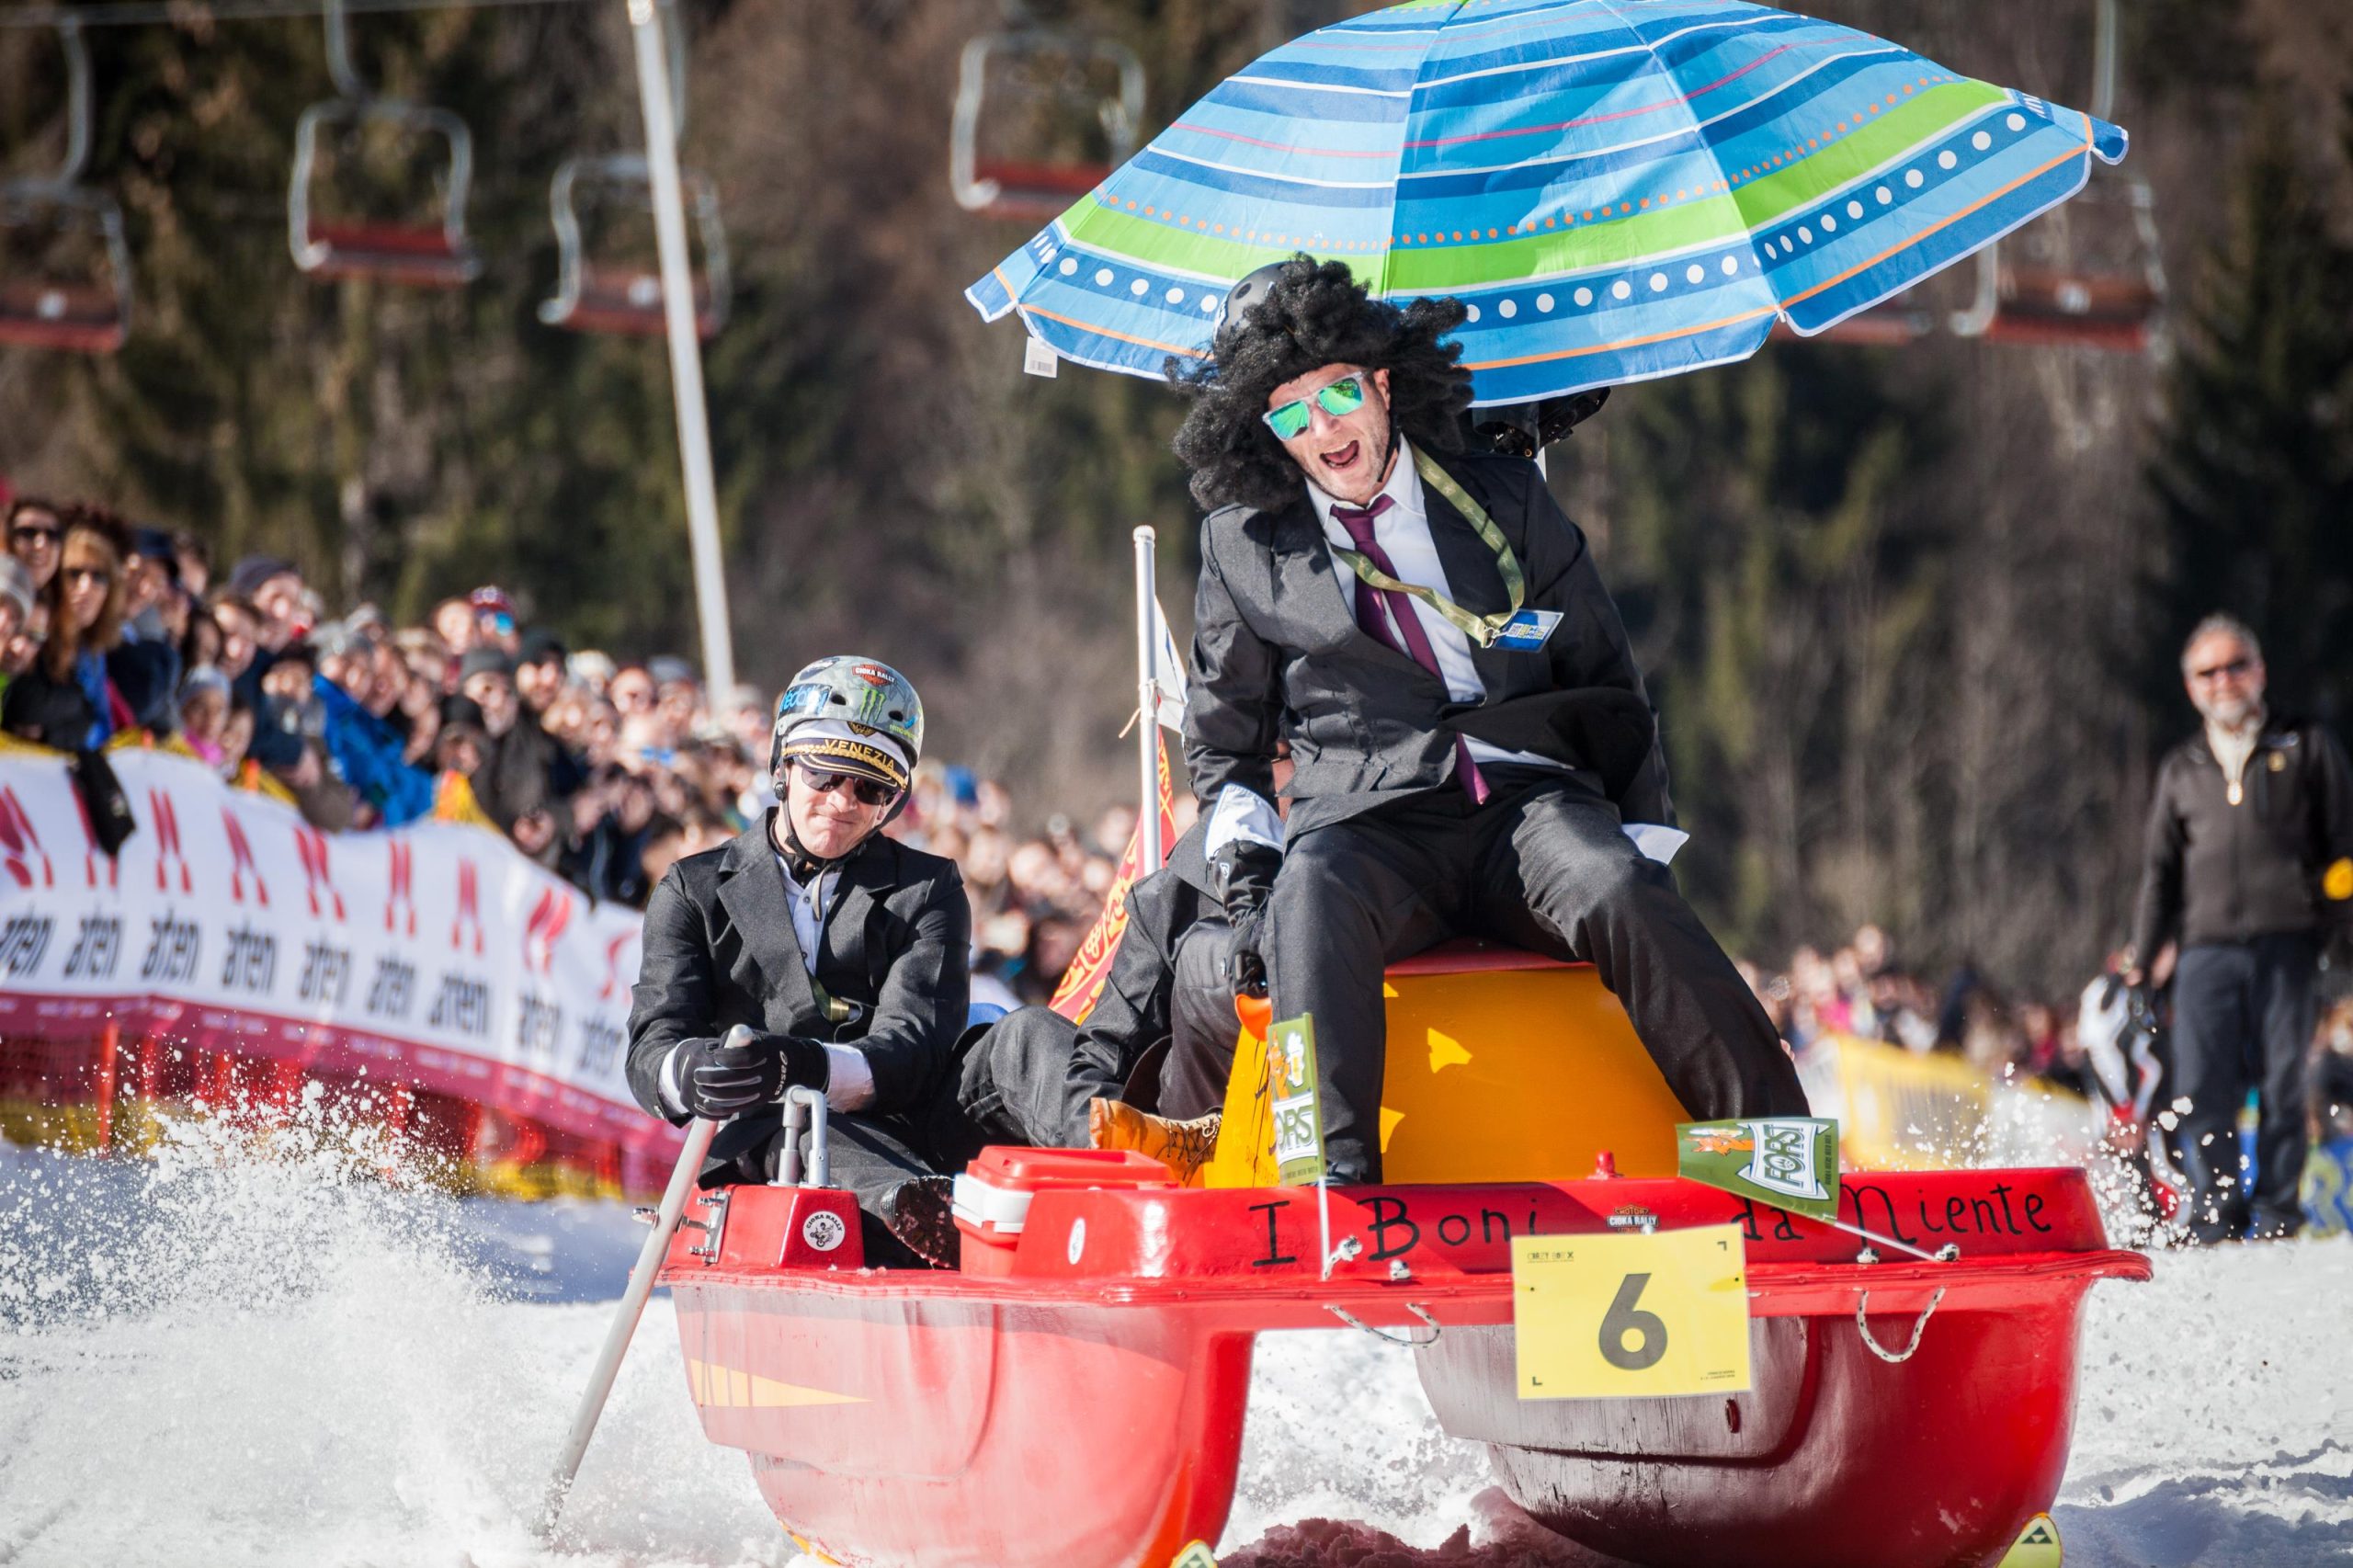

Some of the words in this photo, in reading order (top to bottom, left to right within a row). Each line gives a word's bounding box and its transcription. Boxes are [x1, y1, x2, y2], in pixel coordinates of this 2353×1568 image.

[824, 738, 895, 771] VENEZIA
[1274, 1104, 1316, 1152] ORS
[1763, 1123, 1806, 1189] FORST
[806, 1214, 824, 1229] CIOKA
[825, 1214, 843, 1232] RALLY
[1248, 1199, 1297, 1267] I
[1356, 1196, 1548, 1262] Boni
[1608, 1215, 1633, 1226] CIOKA
[1633, 1215, 1657, 1227] RALLY
[1598, 1272, 1668, 1371] 6
